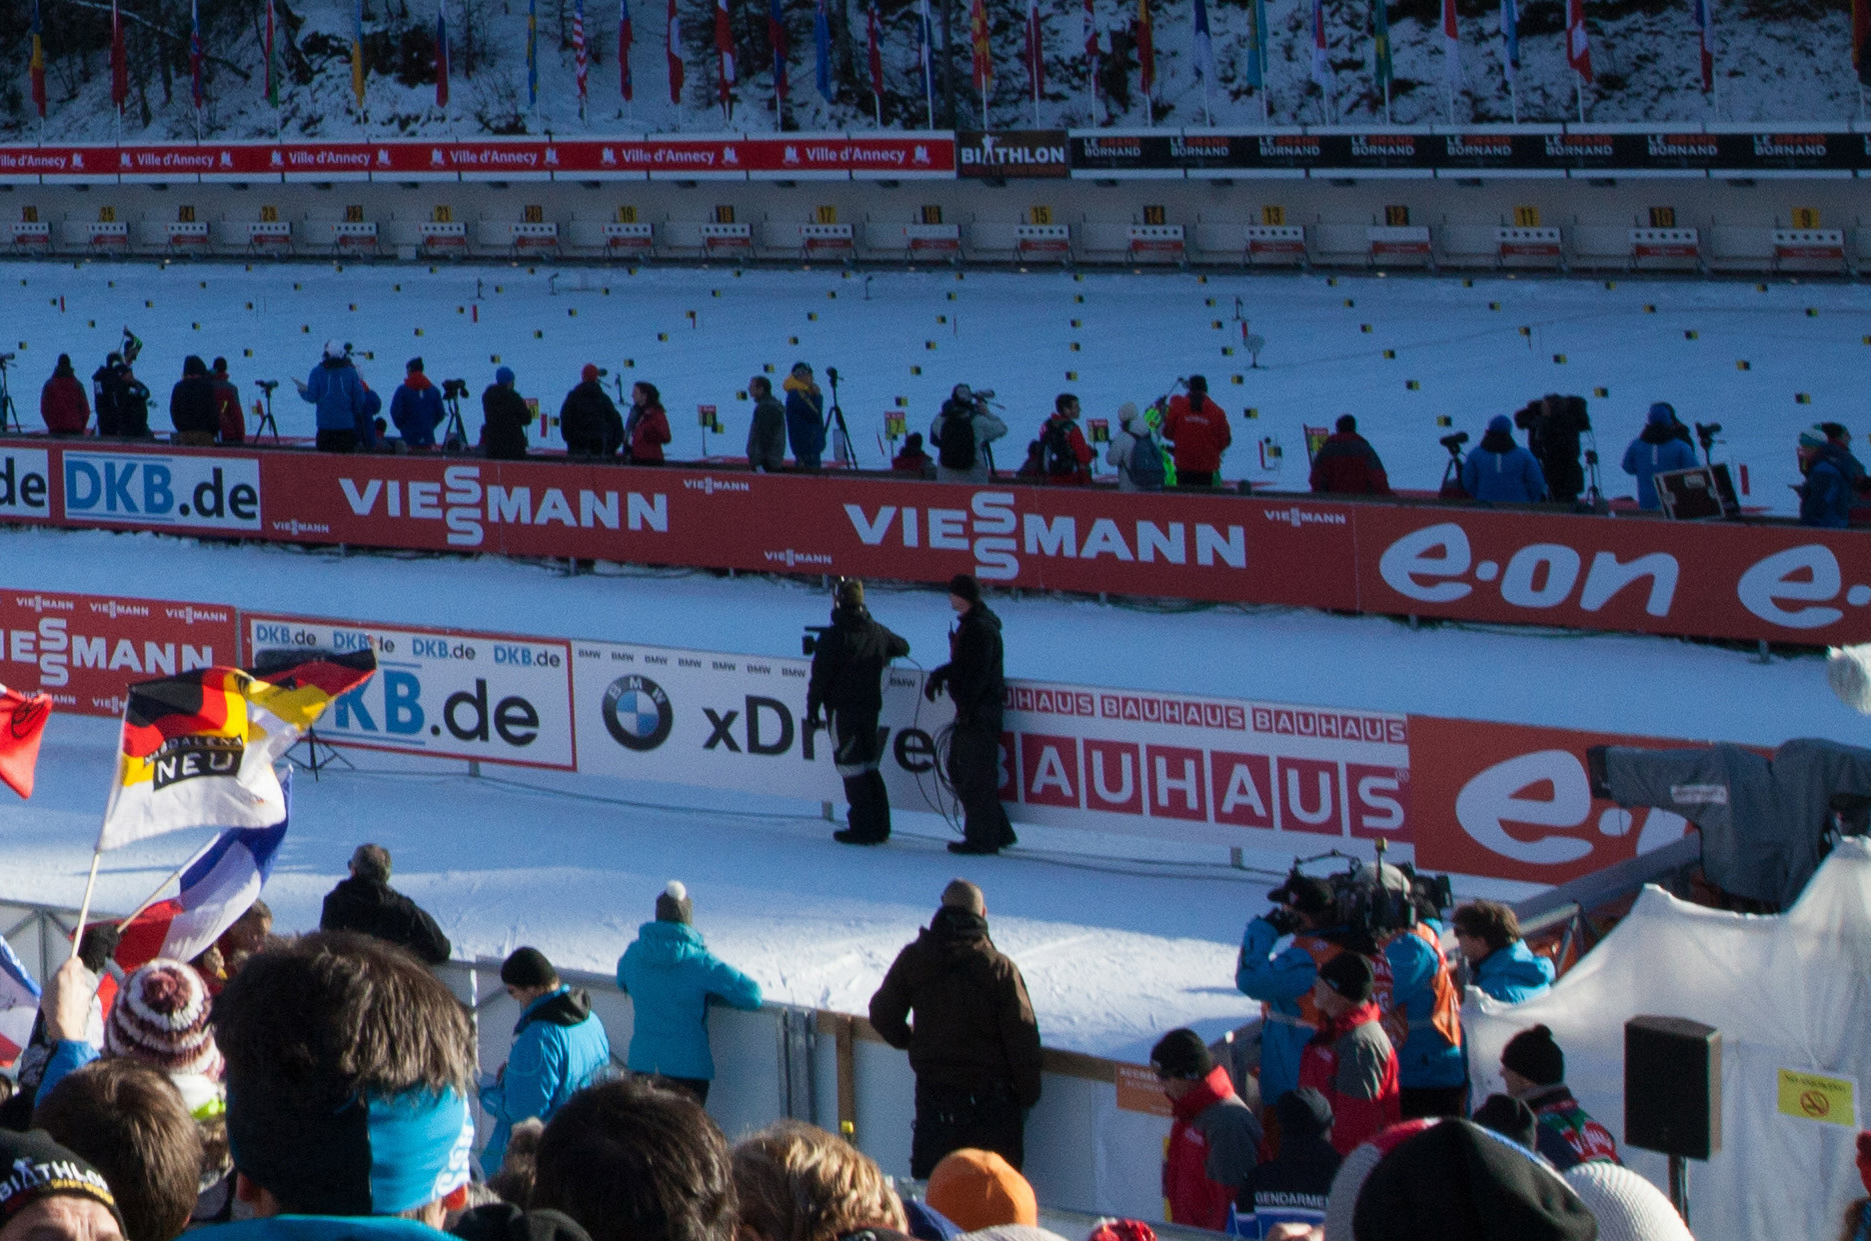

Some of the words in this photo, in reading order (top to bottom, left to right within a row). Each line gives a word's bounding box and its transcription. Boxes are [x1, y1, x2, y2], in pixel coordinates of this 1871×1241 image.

[18, 154, 66, 169] d'Annecy
[137, 153, 161, 166] Ville
[163, 153, 214, 168] d'Annecy
[289, 151, 314, 164] Ville
[316, 151, 371, 167] d'Annecy
[450, 150, 478, 164] Ville
[479, 149, 538, 166] d'Annecy
[622, 148, 651, 163] Ville
[653, 148, 715, 165] d'Annecy
[805, 147, 837, 162] Ville
[840, 147, 906, 164] d'Annecy
[65, 461, 257, 519] DKB.de
[338, 466, 668, 546] VIESSMANN
[843, 491, 1246, 580] VIESSMANN
[257, 624, 316, 646] DKB.de
[412, 638, 476, 660] DKB.de
[493, 645, 561, 667] DKB.de
[578, 649, 601, 659] BMW
[611, 651, 634, 662] BMW
[644, 655, 668, 665] BMW
[678, 658, 702, 669] BMW
[712, 661, 736, 671] BMW
[747, 664, 771, 675] BMW
[782, 667, 806, 678] BMW
[889, 676, 915, 688] BMW
[335, 671, 540, 747] KB.de
[1103, 695, 1244, 730] BAUHAUS
[1254, 708, 1406, 743] BAUHAUS
[158, 751, 234, 784] NEU
